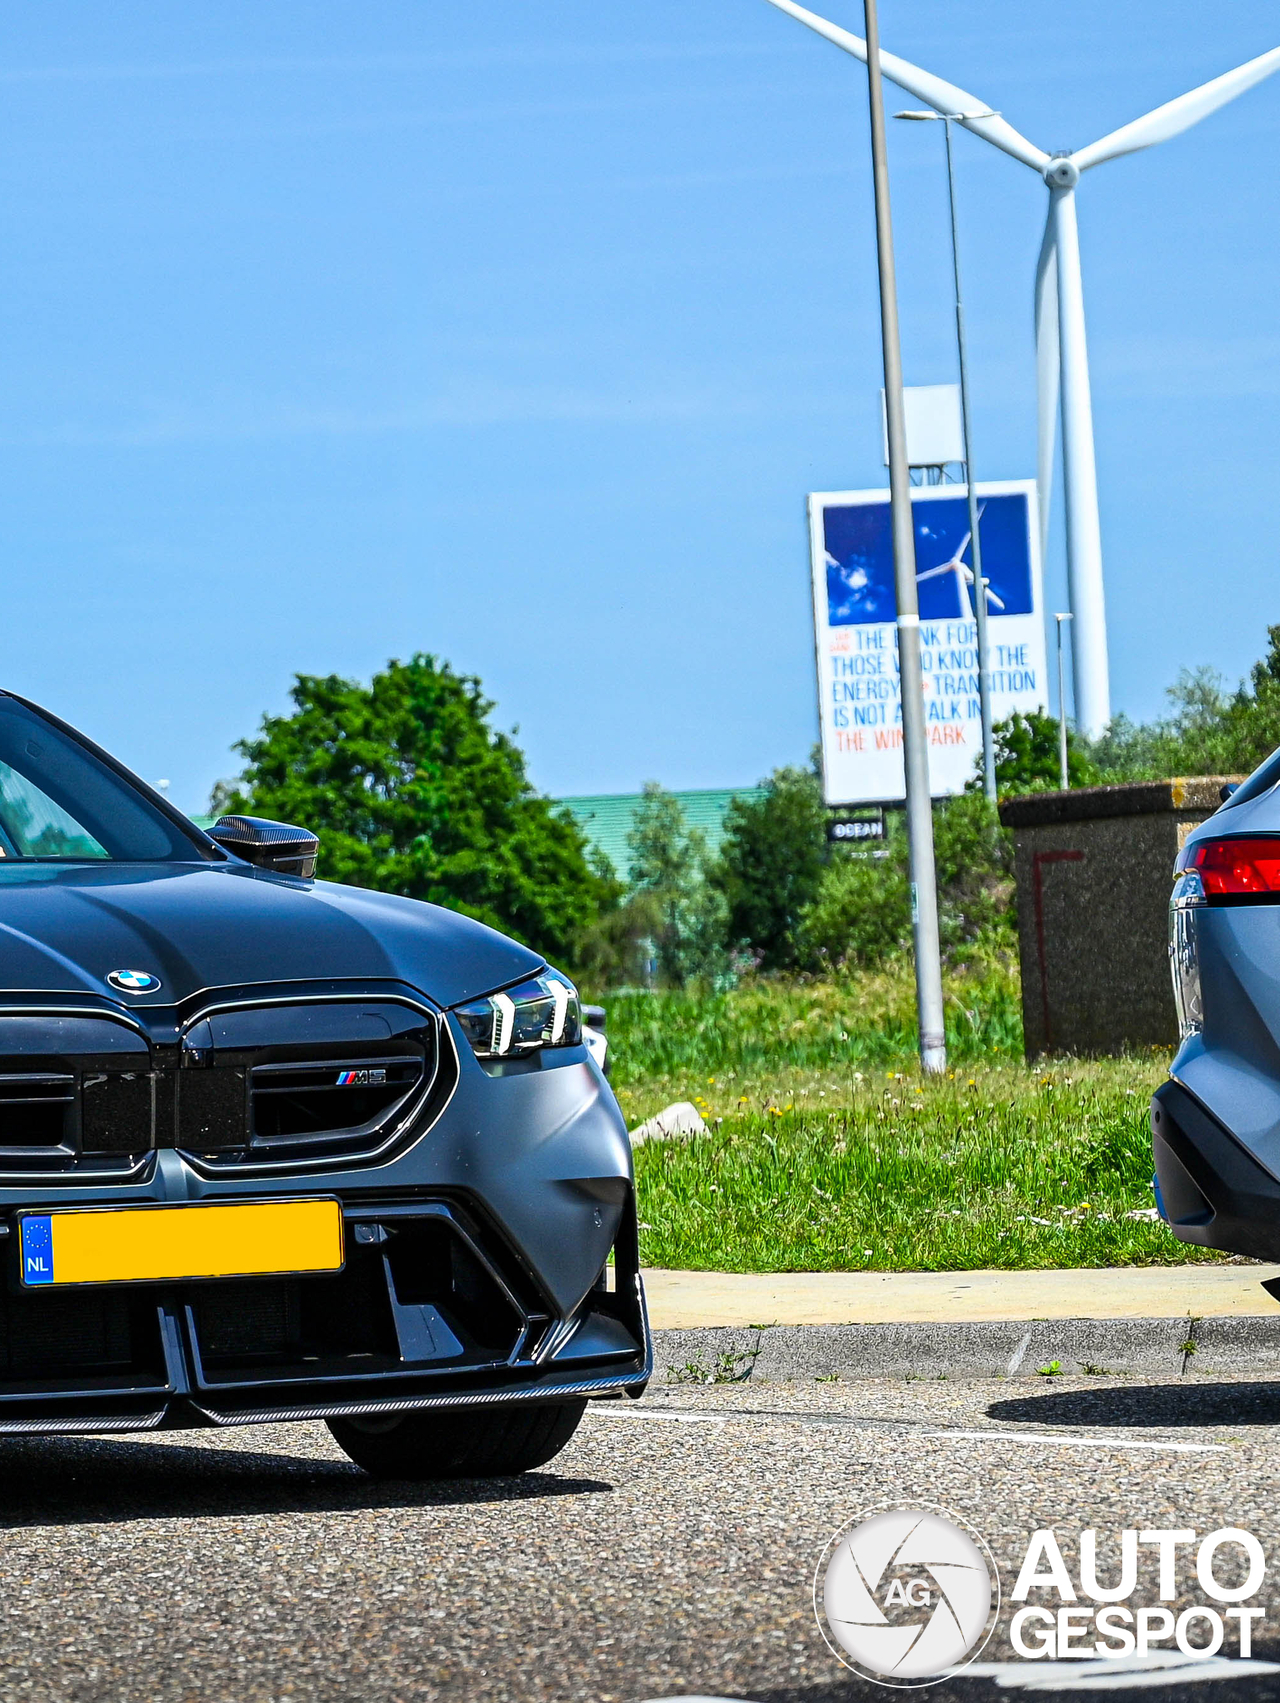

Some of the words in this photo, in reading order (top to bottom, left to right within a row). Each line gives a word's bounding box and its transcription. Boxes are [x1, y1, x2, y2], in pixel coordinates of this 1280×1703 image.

[855, 627, 887, 650] THE
[830, 653, 887, 677] THOSE
[938, 647, 979, 671] KNO
[996, 642, 1029, 667] THE
[832, 676, 900, 702] ENERGY
[933, 669, 1036, 696] TRANITION
[834, 704, 849, 728] IS
[854, 702, 886, 725] NOT
[924, 699, 961, 722] ALK
[836, 728, 867, 752] THE
[26, 1256, 50, 1273] NL
